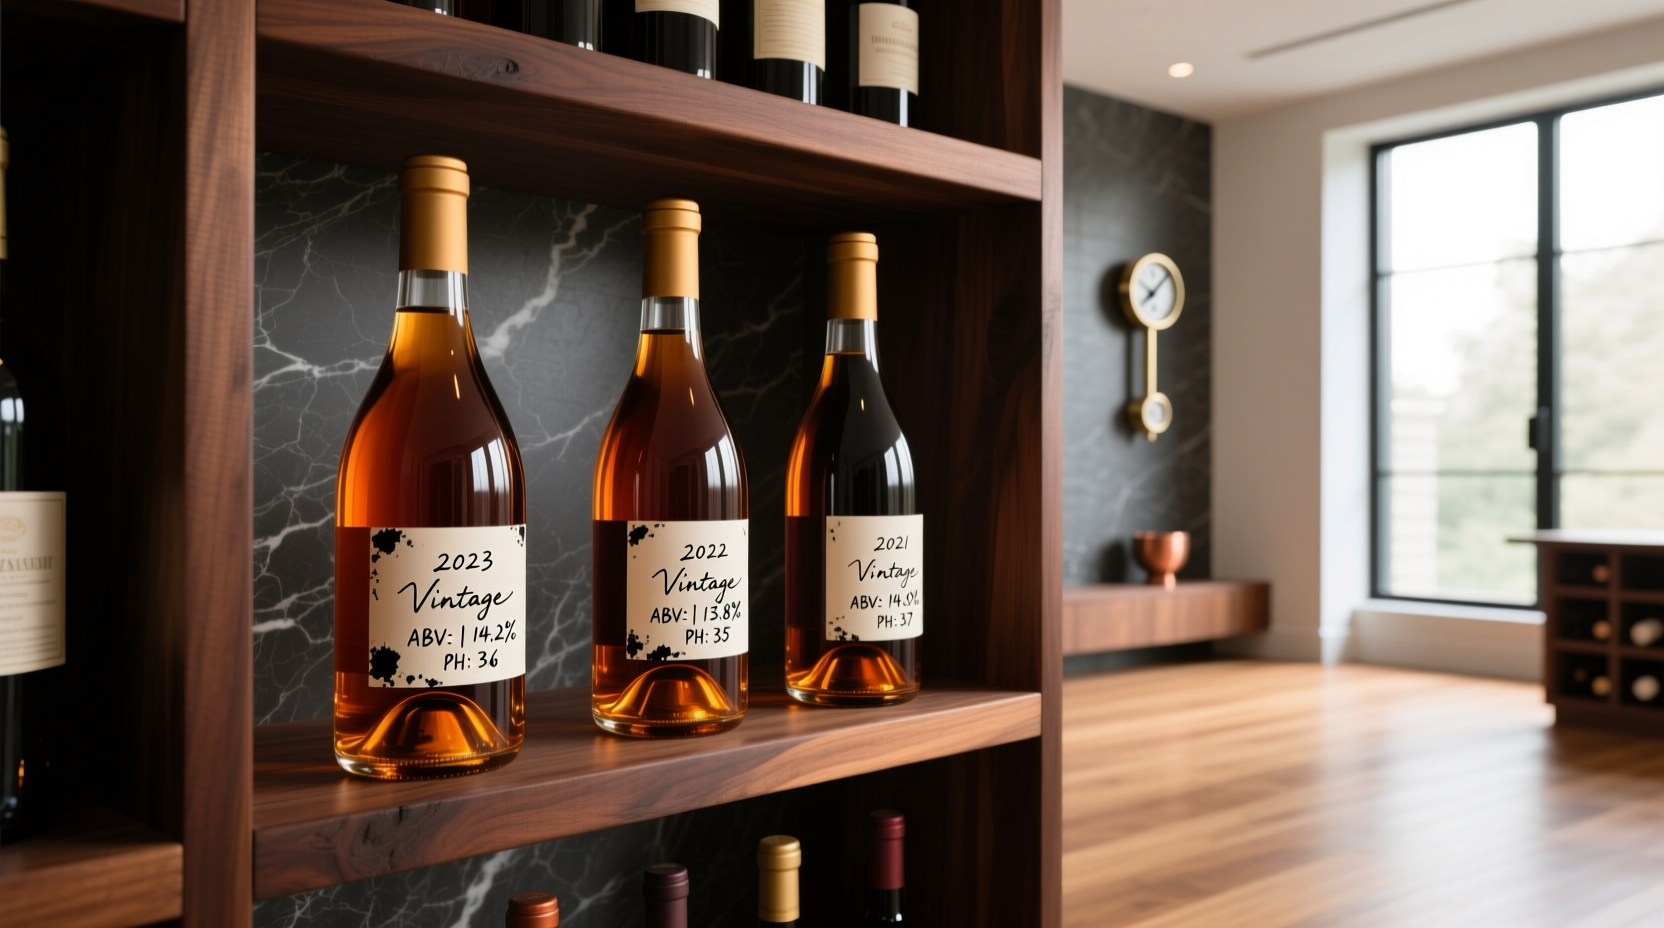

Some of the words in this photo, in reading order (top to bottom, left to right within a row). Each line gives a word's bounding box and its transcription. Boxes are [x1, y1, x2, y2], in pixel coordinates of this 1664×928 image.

[680, 543, 728, 561] 2022
[874, 535, 908, 551] 2021
[433, 550, 493, 572] 2023
[848, 559, 919, 588] Vintage
[652, 567, 742, 604] Vintage
[397, 578, 513, 620] Vintage
[850, 595, 882, 610] ABV:
[650, 607, 688, 624] ABV:
[703, 600, 741, 622] 13.8%
[877, 615, 898, 629] PH:
[900, 612, 913, 627] 37
[407, 627, 453, 647] ABV:
[473, 619, 517, 643] 14.2%
[685, 629, 709, 645] PH:
[713, 626, 731, 643] 35
[443, 652, 471, 671] PH:
[477, 648, 498, 668] 36
